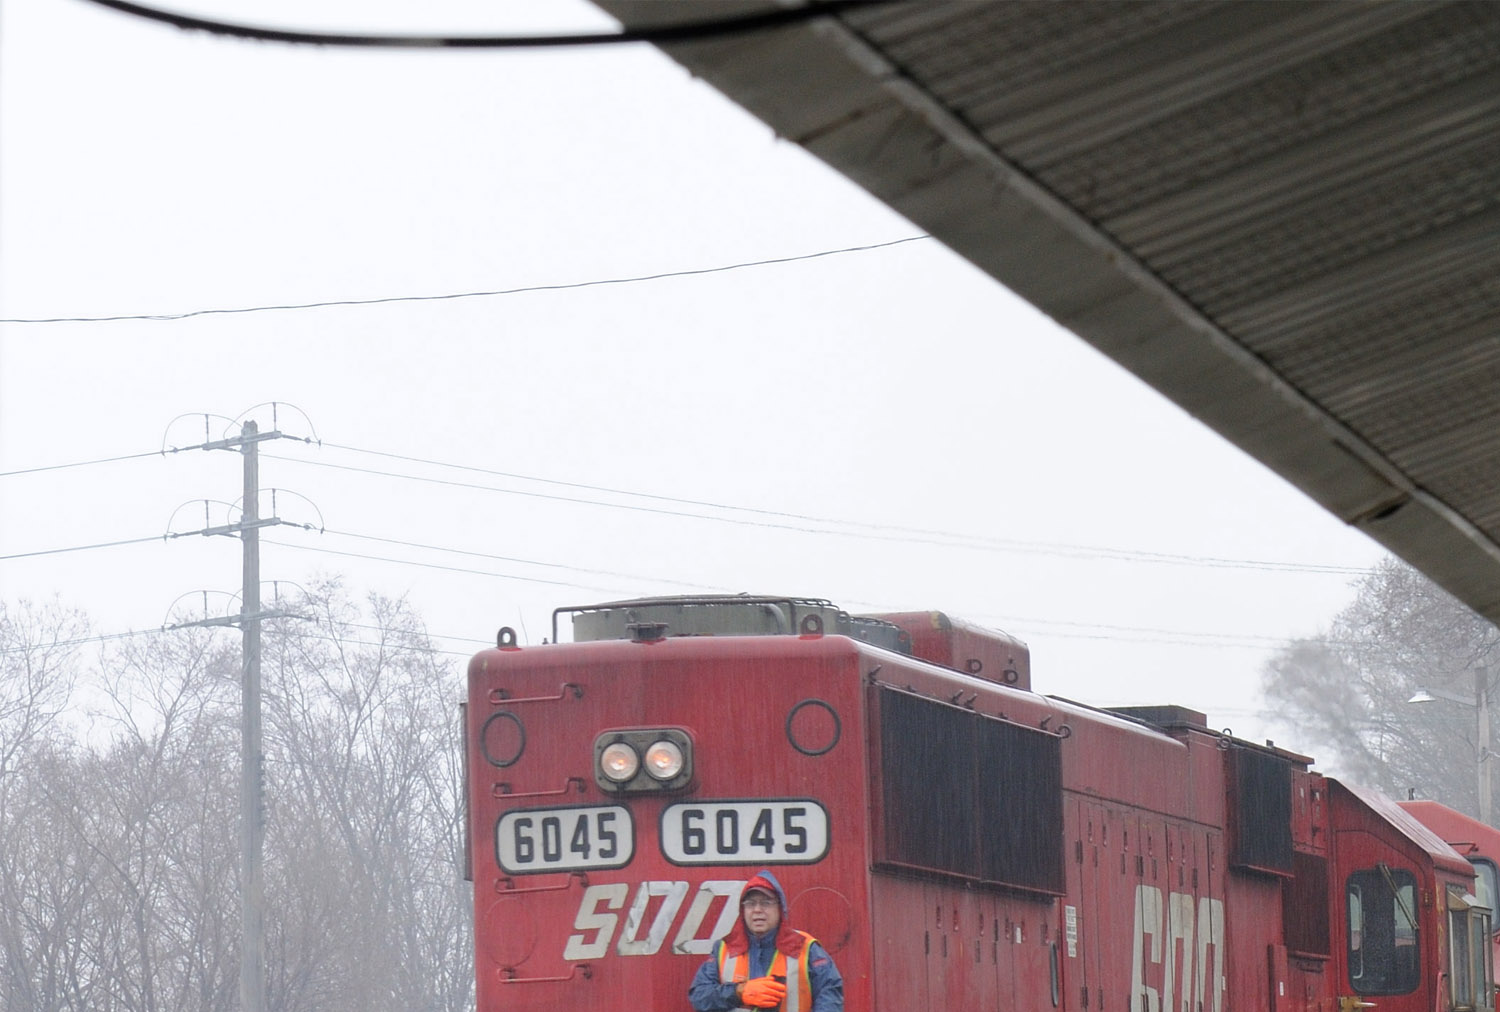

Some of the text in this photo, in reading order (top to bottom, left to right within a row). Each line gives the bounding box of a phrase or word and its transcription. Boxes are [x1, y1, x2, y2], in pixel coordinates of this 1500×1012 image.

[513, 811, 618, 864] 6045
[681, 807, 808, 855] 6045
[563, 880, 749, 961] SOO
